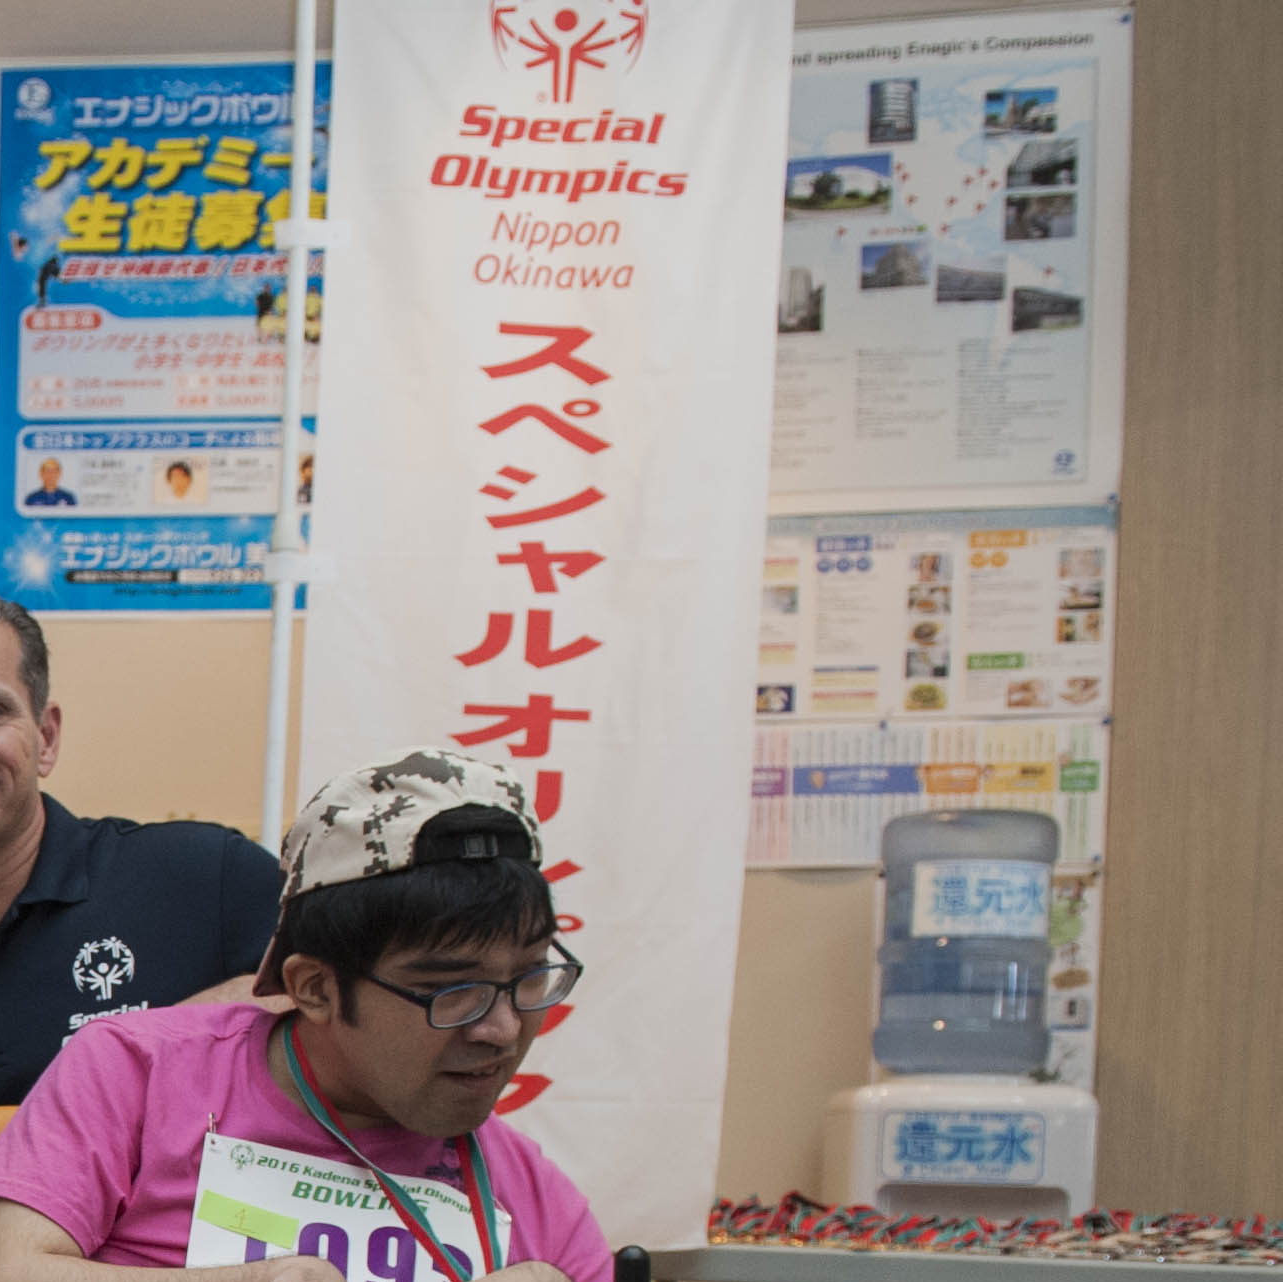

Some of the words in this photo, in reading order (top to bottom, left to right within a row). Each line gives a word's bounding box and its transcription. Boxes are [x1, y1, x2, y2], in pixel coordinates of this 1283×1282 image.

[817, 43, 902, 66] spreading
[986, 30, 1095, 51] Compassion
[458, 104, 666, 148] Special
[430, 154, 689, 203] Olympics
[491, 211, 622, 254] Nippon
[473, 253, 636, 289] Okinawa
[257, 1154, 300, 1174] 2016
[302, 1165, 361, 1187] Kadena
